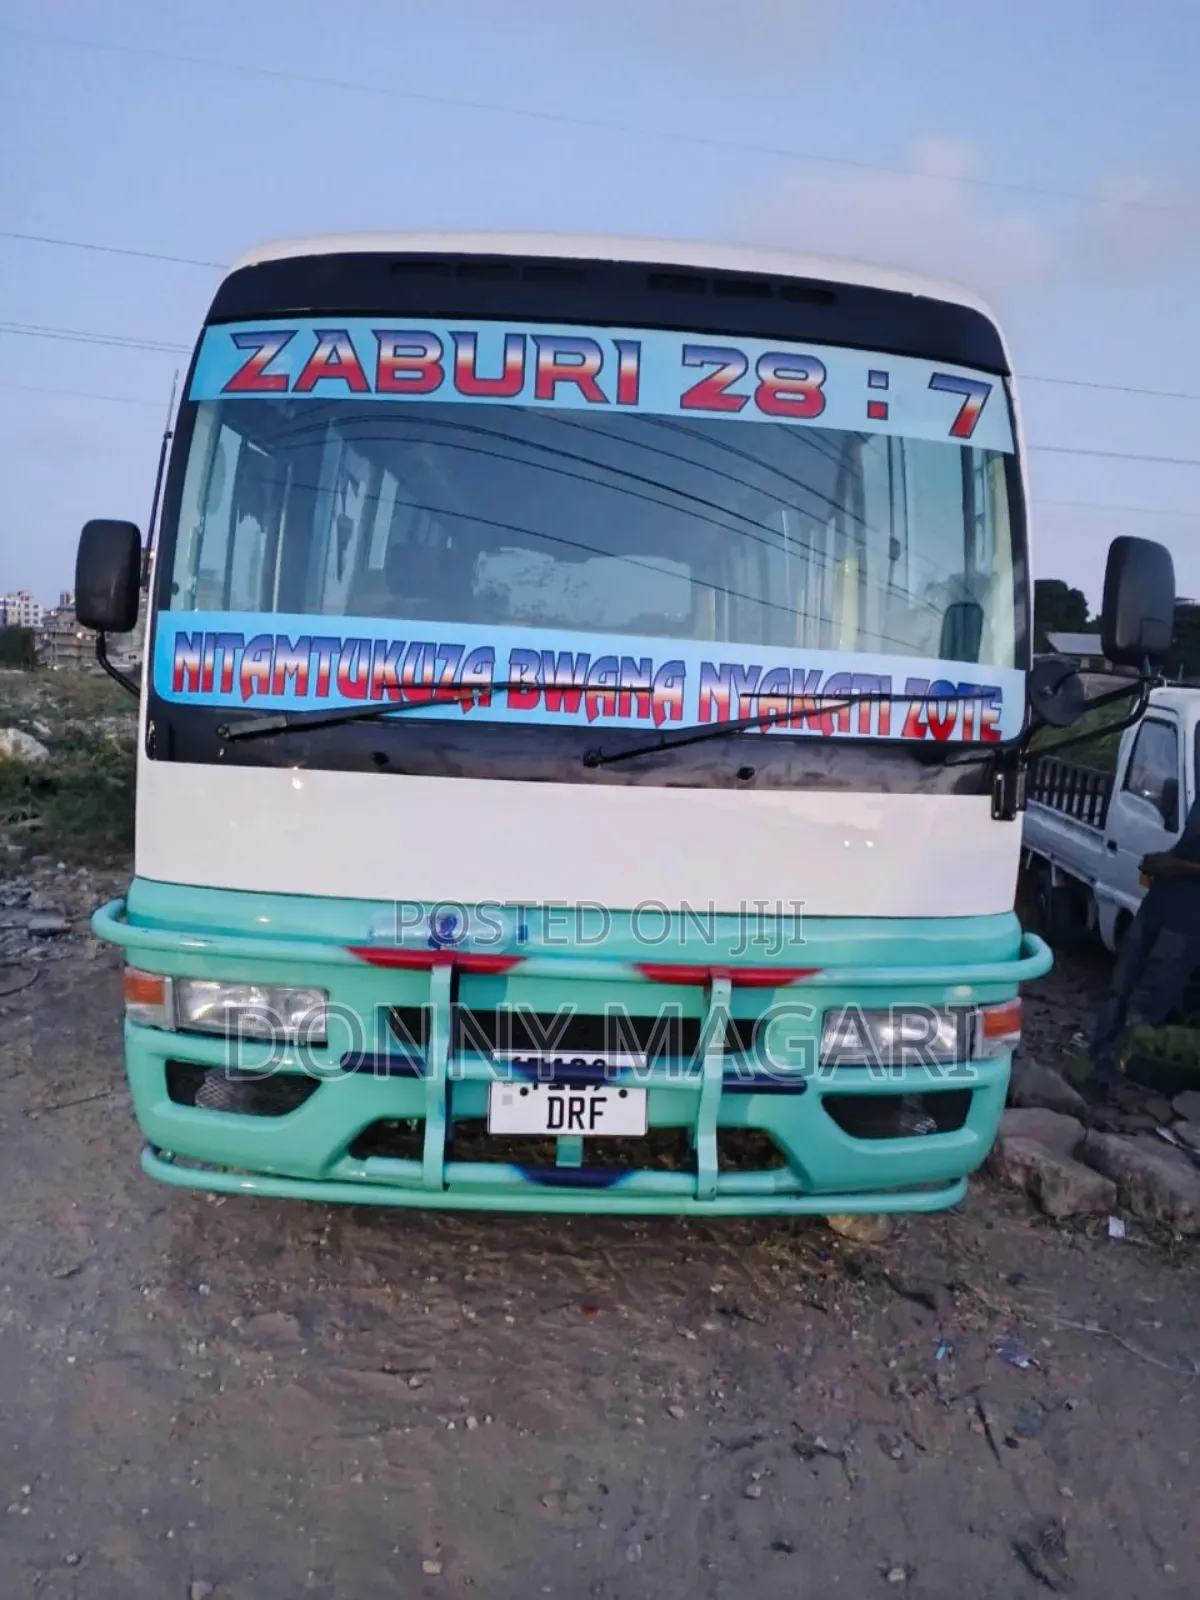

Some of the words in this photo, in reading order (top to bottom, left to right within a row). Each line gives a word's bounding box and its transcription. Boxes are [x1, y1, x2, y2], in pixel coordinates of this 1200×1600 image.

[221, 328, 642, 406] ZABURI
[680, 343, 827, 419] 28
[867, 369, 890, 420] :
[928, 371, 993, 439] 7
[172, 631, 496, 714] NITAMTUKUZA
[507, 648, 687, 729] BWANA
[699, 661, 893, 737] NYAKATI
[546, 1096, 608, 1130] DRF
